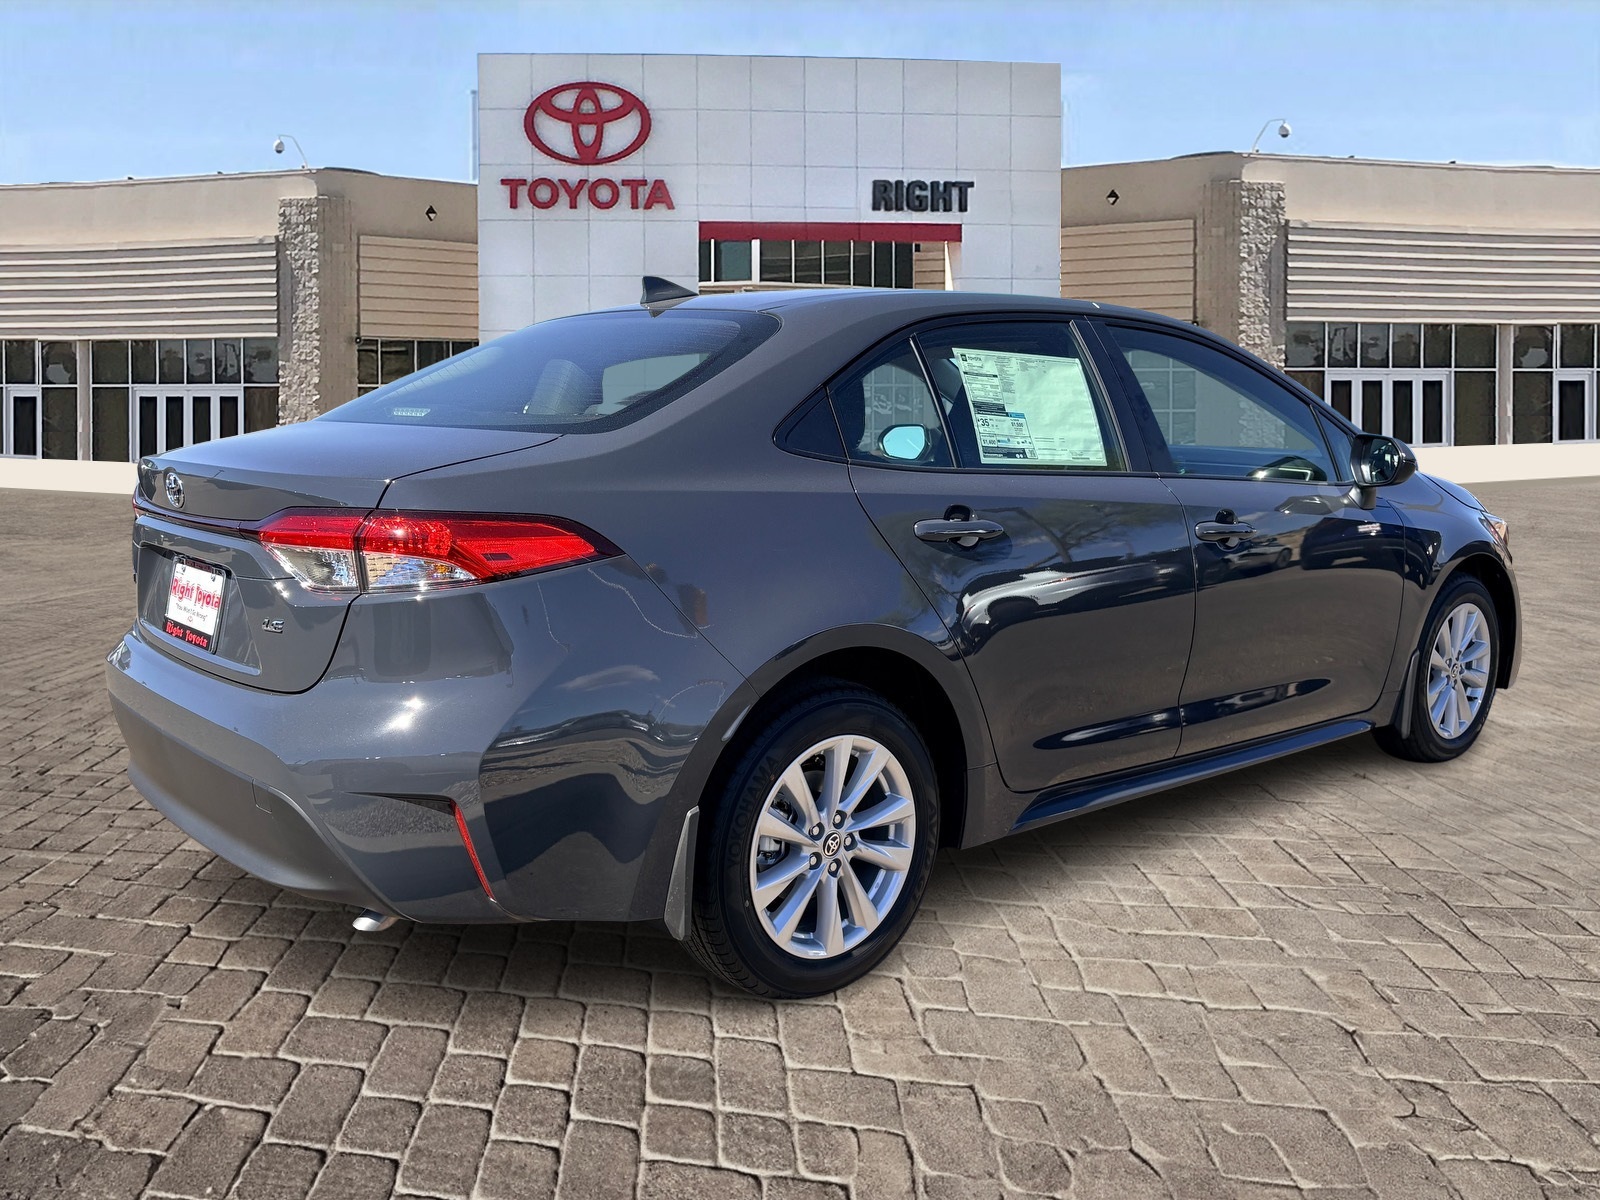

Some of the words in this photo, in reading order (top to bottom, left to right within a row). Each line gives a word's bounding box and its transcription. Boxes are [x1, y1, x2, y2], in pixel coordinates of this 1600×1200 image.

[500, 178, 675, 210] TOYOTA
[872, 179, 975, 213] RIGHT
[980, 418, 990, 427] 35
[171, 578, 195, 601] Right
[195, 585, 221, 609] Toyota
[166, 621, 184, 637] Right
[185, 630, 208, 647] Toyota
[262, 617, 285, 634] LE
[727, 755, 779, 869] YOKOHAMA
